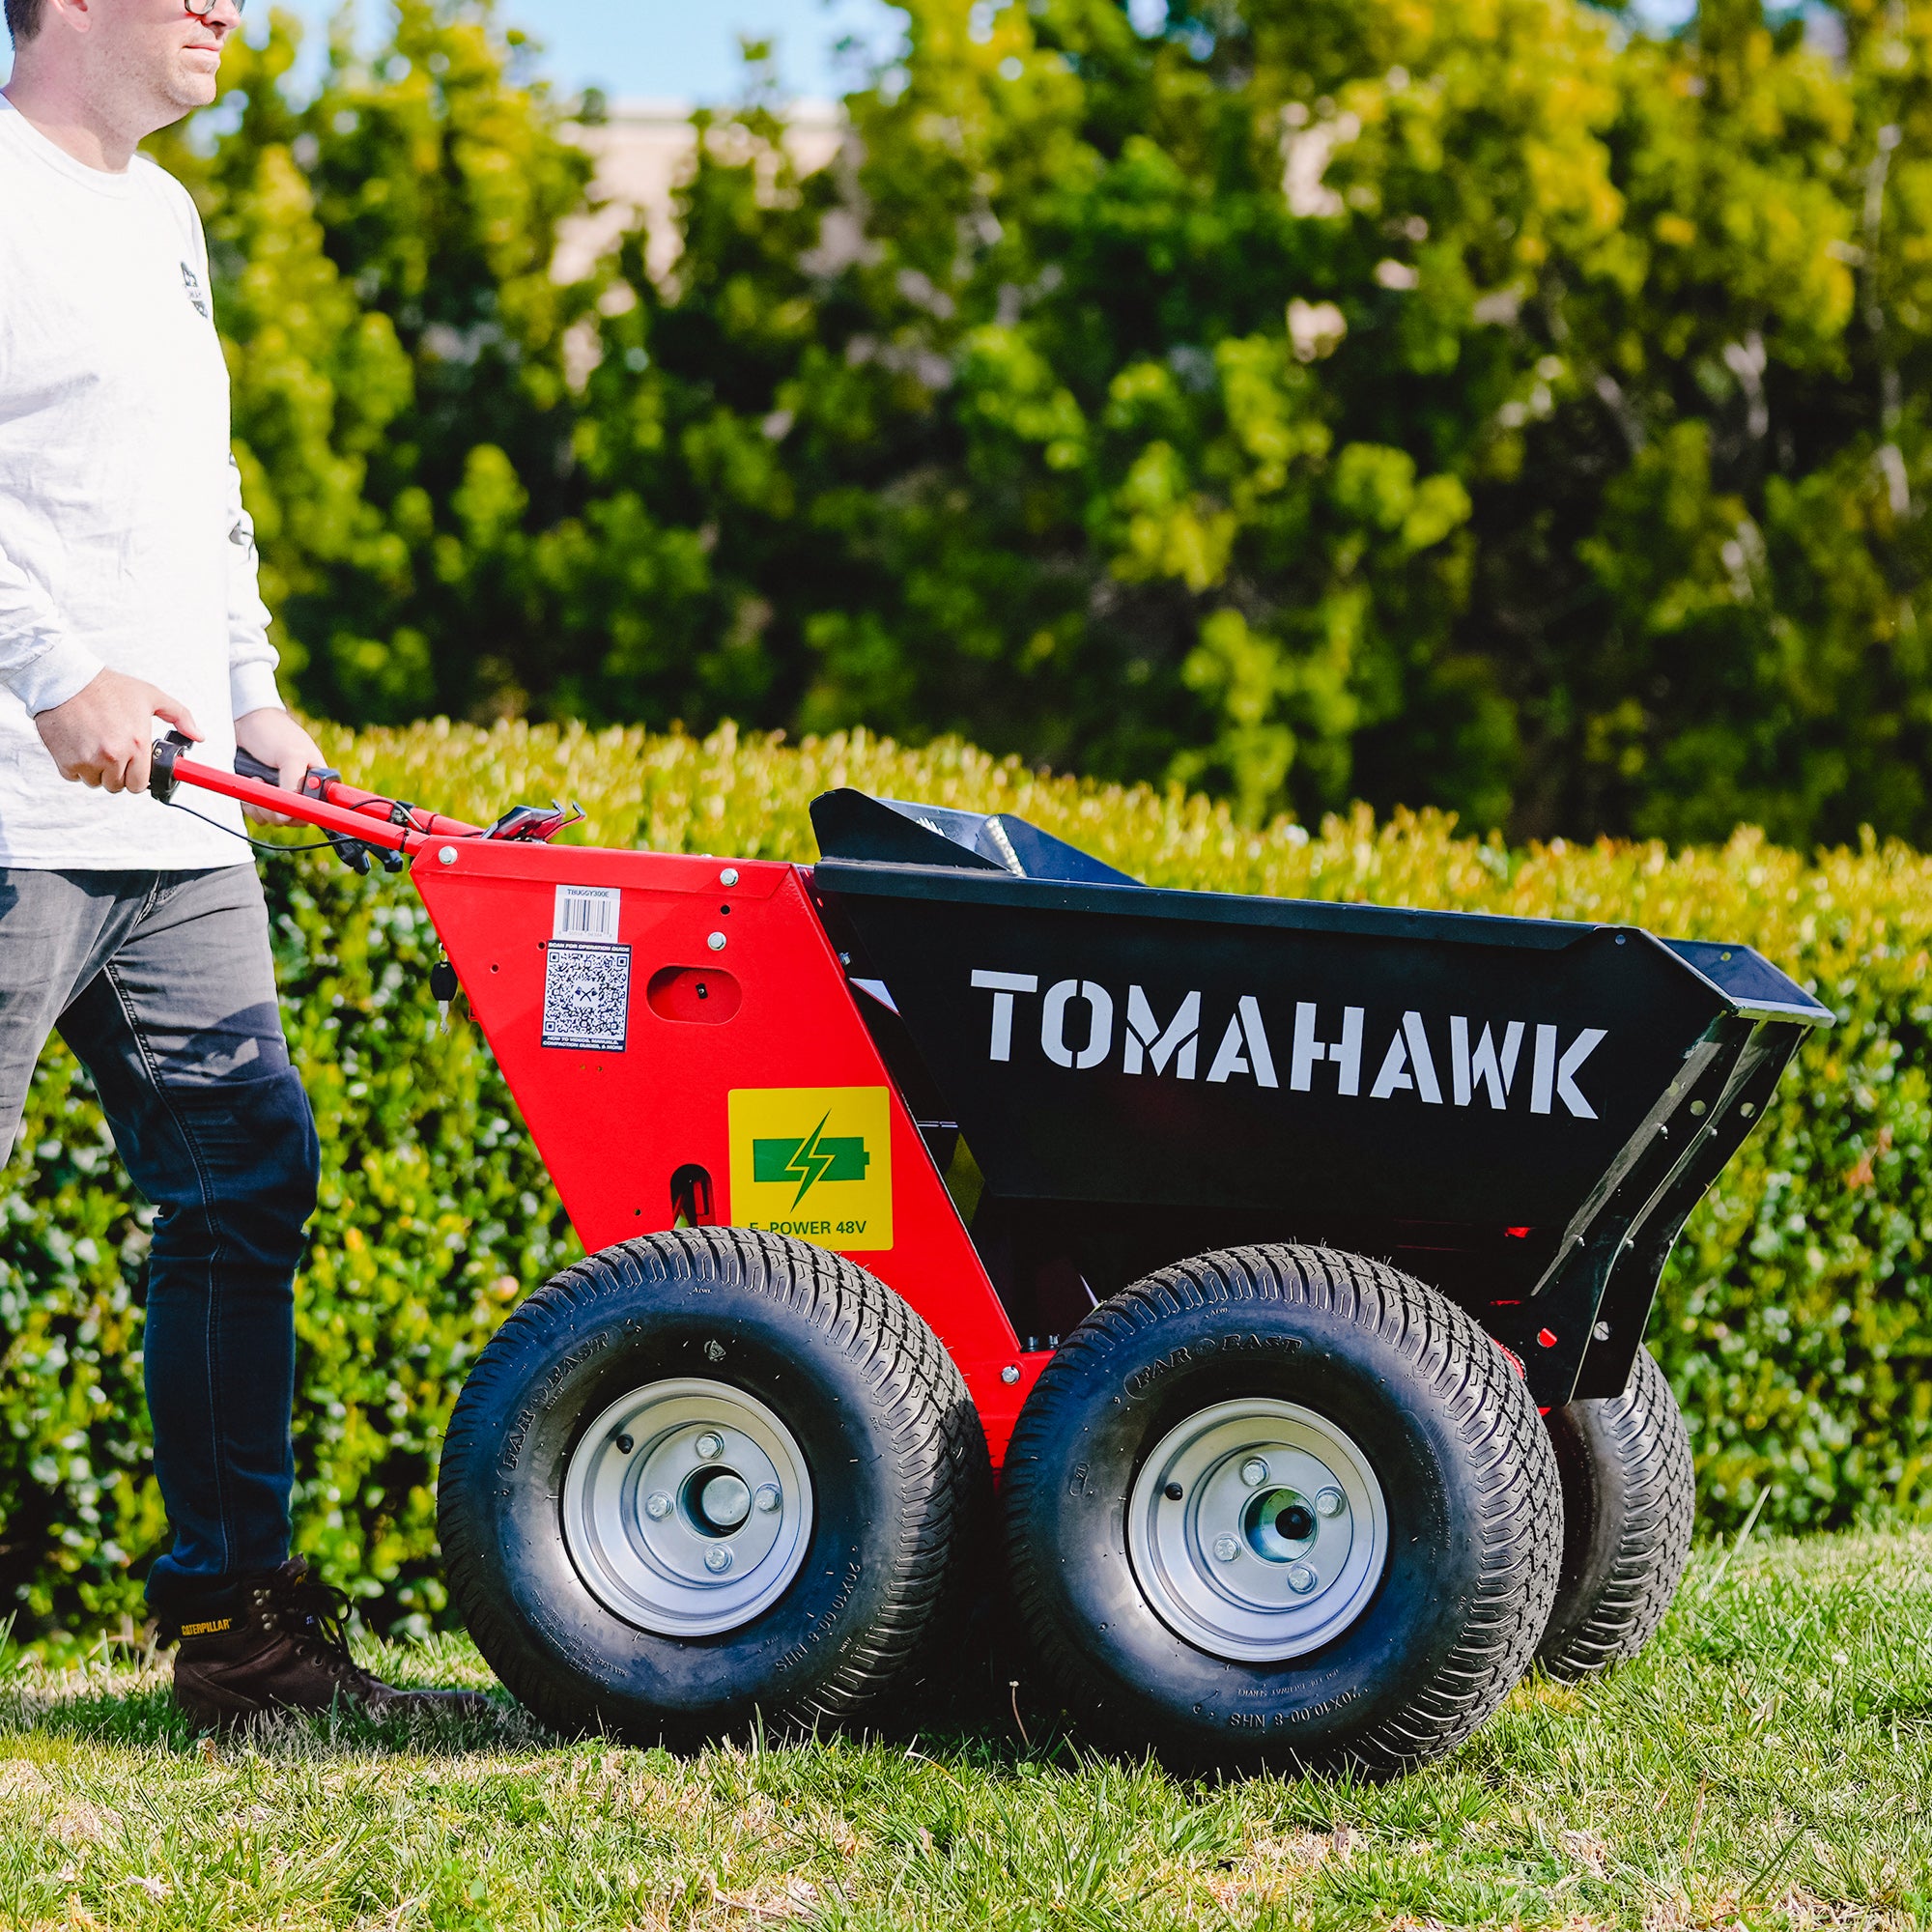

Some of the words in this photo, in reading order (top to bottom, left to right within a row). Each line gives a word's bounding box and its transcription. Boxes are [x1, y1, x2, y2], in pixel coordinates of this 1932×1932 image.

[567, 888, 610, 897] TBUGGY300E
[971, 969, 1608, 1119] TOMAHAWK
[836, 1220, 867, 1234] 48V
[1133, 1346, 1193, 1389] FAR
[1221, 1333, 1303, 1354] EAST
[502, 1408, 536, 1469] FAR
[545, 1331, 609, 1388] EAST
[181, 1618, 230, 1635] CATERPILLAR
[1230, 1712, 1266, 1728] NHS
